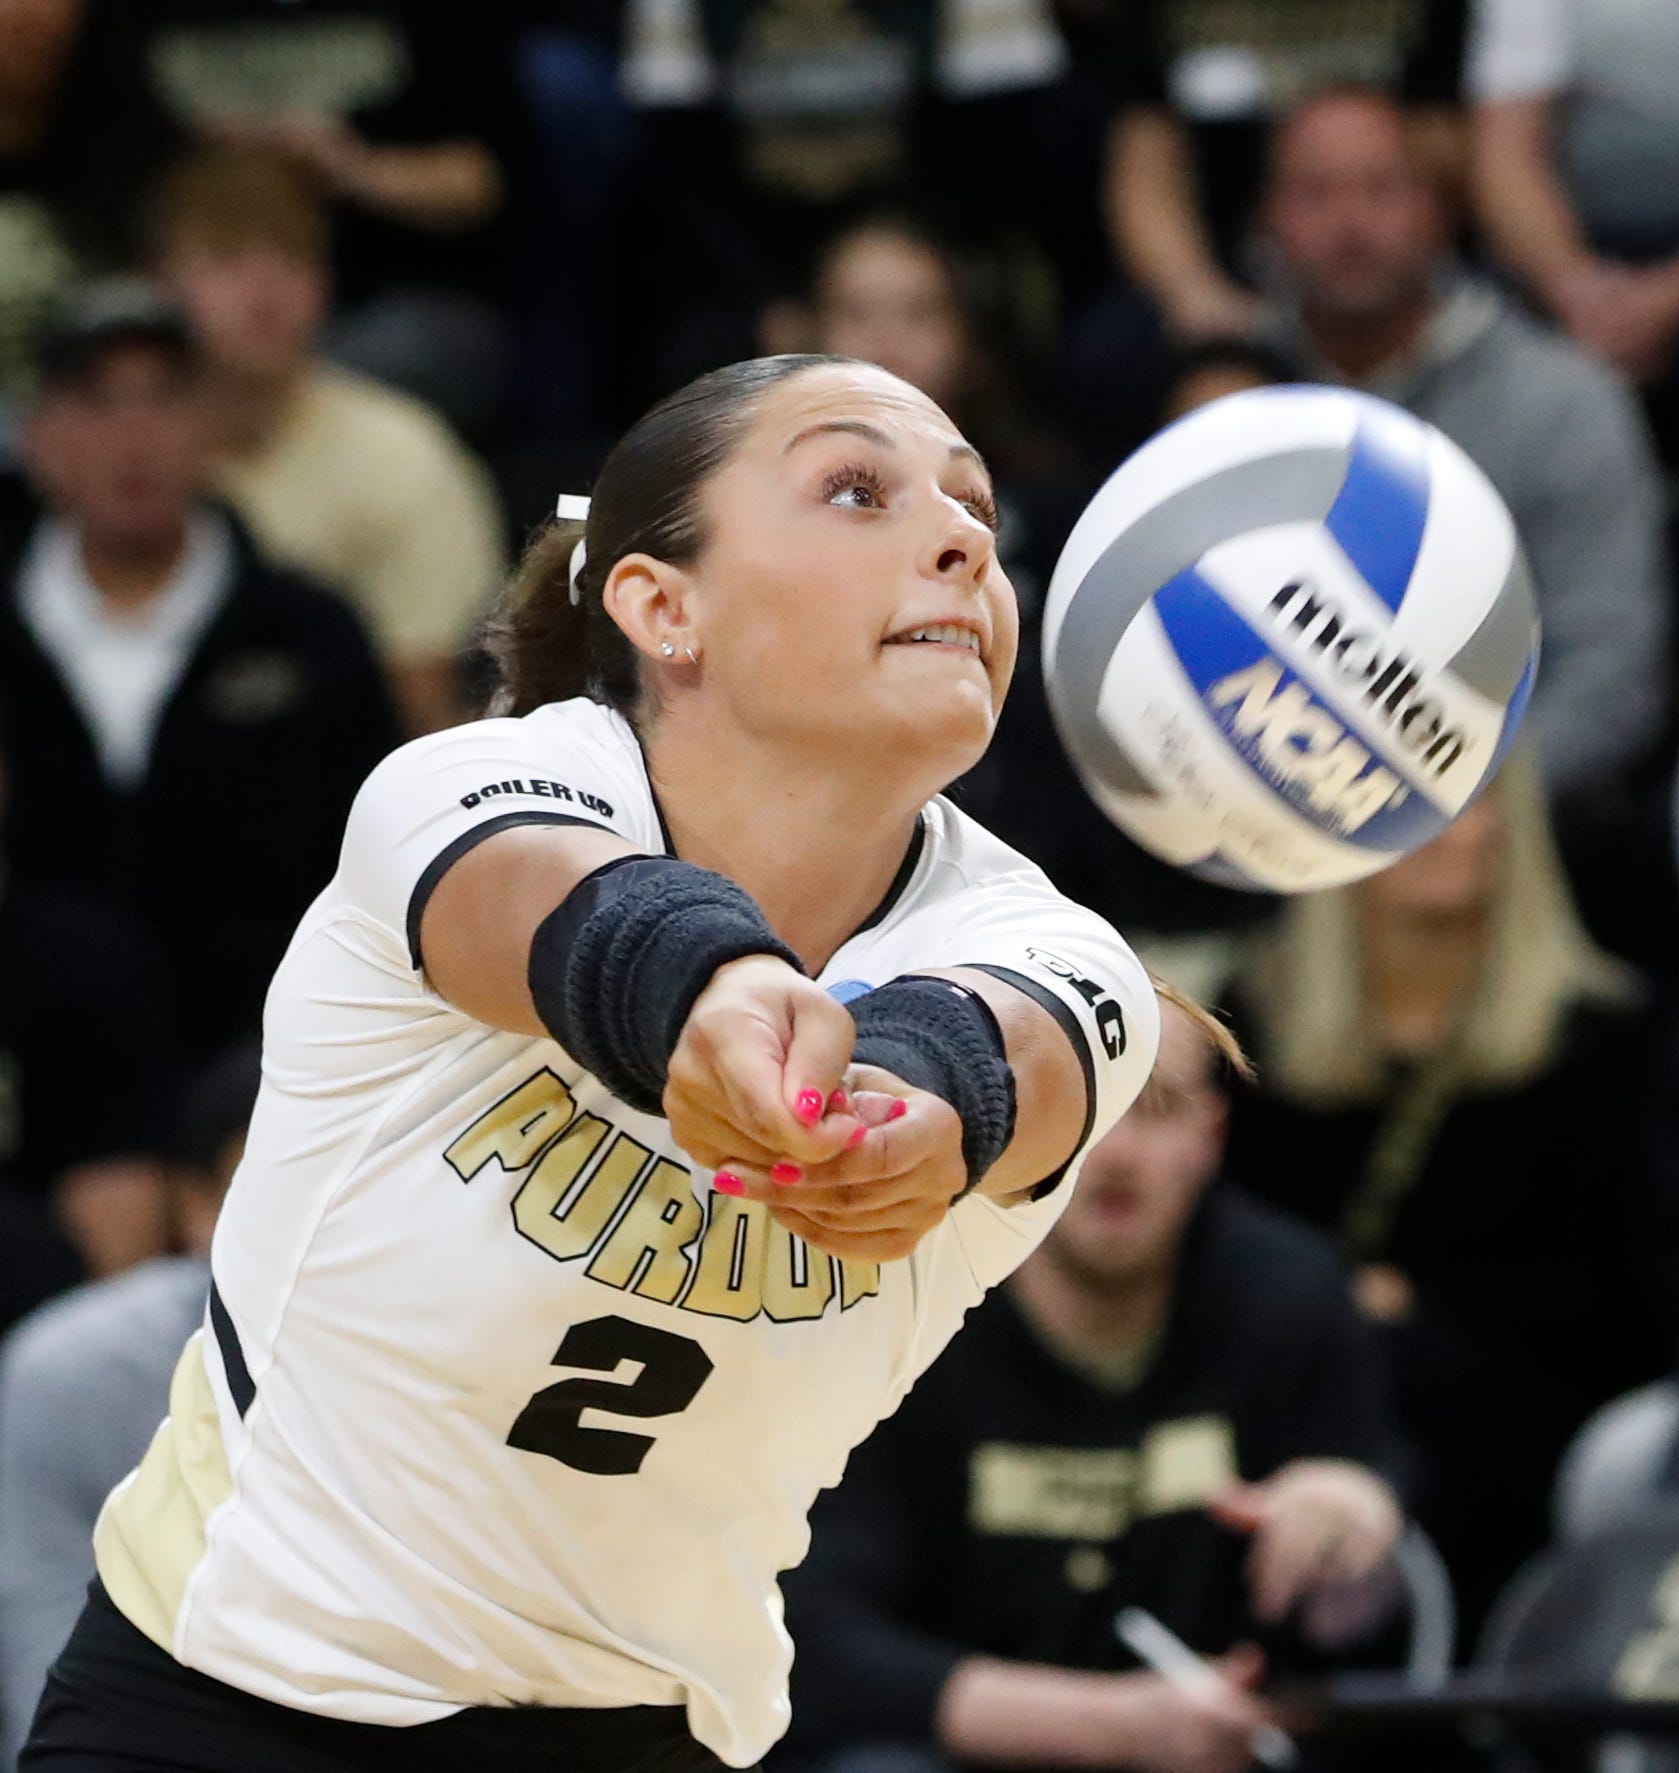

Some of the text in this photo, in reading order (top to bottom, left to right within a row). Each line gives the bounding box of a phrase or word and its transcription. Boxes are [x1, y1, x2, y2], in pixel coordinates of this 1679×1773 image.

[1263, 576, 1474, 782] molten
[460, 779, 615, 819] BOILER UP
[442, 1066, 882, 1324] PURDU
[505, 1314, 715, 1476] 2
